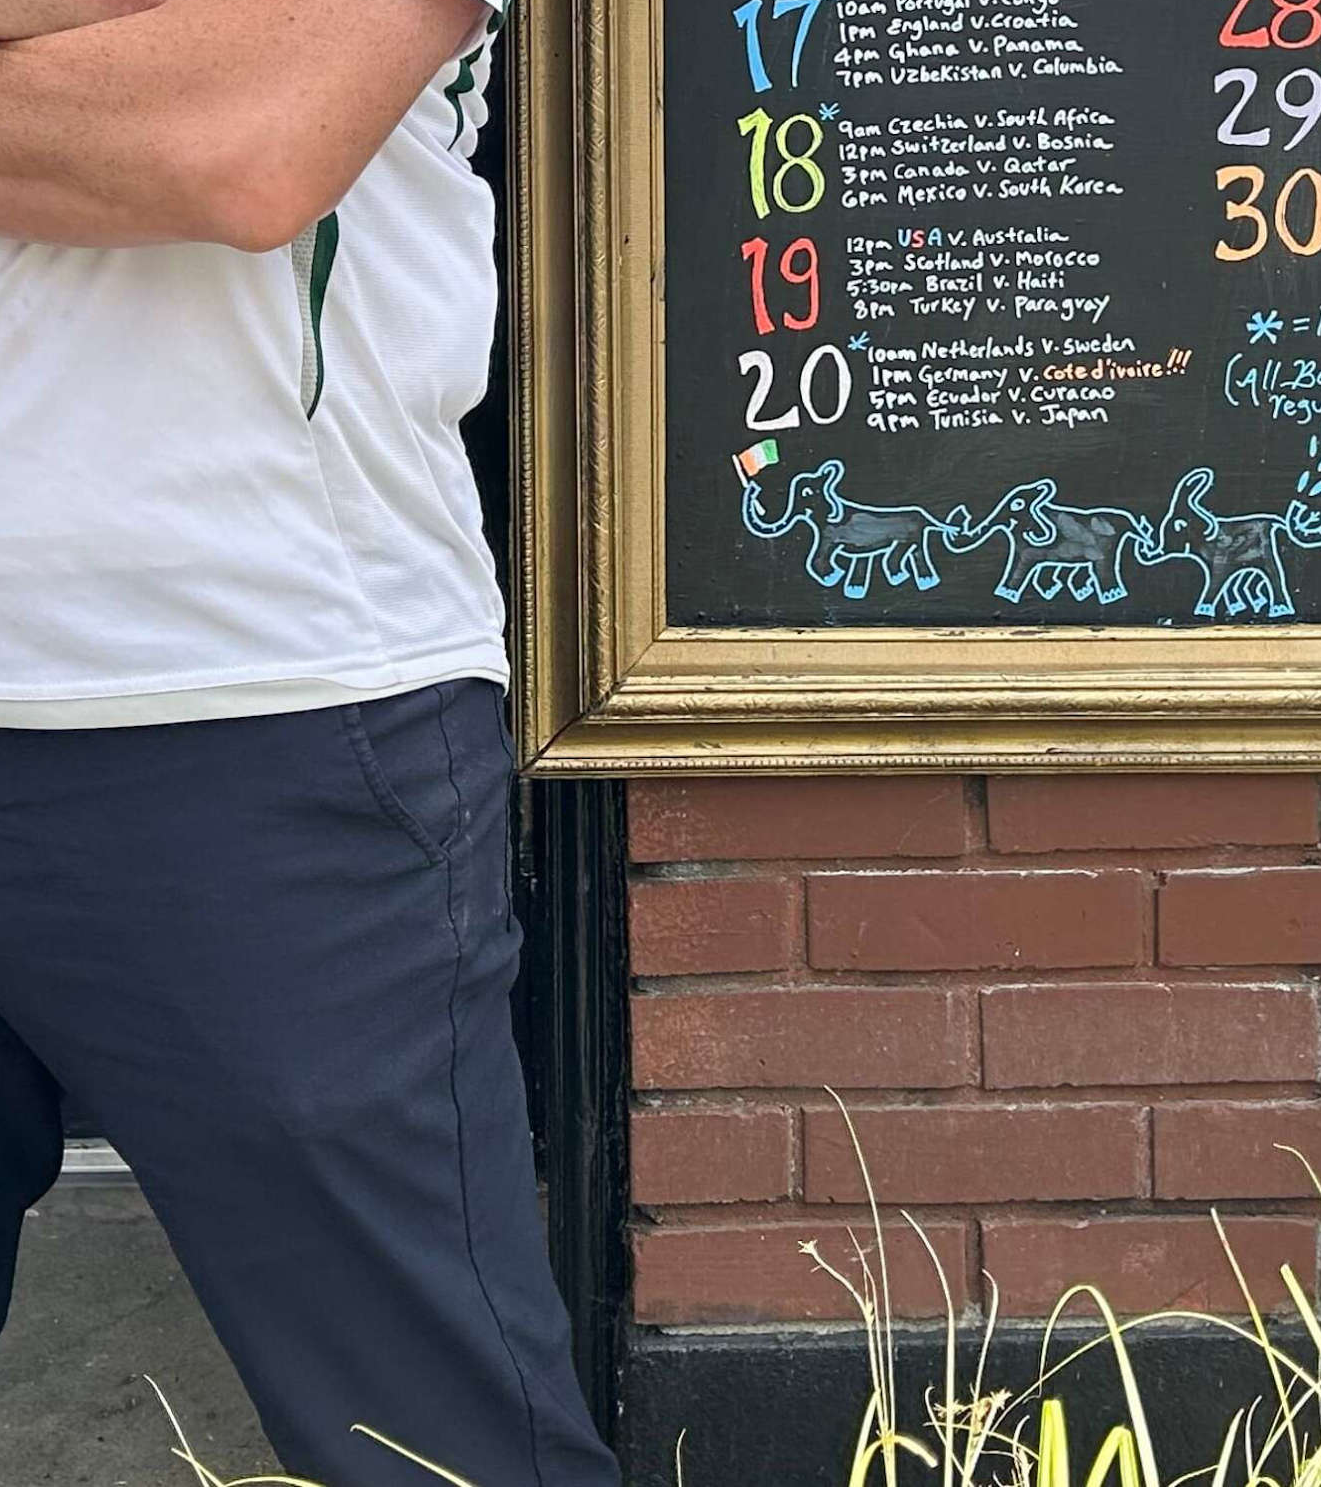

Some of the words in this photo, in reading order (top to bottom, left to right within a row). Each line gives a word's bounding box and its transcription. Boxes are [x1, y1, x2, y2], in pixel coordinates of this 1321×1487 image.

[886, 12, 964, 41] England
[888, 41, 960, 64] Ghana
[993, 34, 1084, 58] Panama
[1032, 55, 1124, 76] Columbia
[1037, 132, 1114, 151] Bosnia
[737, 107, 825, 220] 18
[887, 113, 969, 135] Czechia
[996, 106, 1049, 127] South
[897, 183, 967, 207] Mexico
[997, 176, 1052, 199] South
[1059, 174, 1124, 195] Korea
[741, 236, 819, 335] 19
[897, 227, 942, 248] USA
[972, 226, 1070, 247] Australia
[925, 272, 983, 293] Brazil
[1017, 270, 1065, 291] Haiti
[738, 344, 852, 431] 20
[921, 334, 1034, 360] Netherlands
[917, 364, 1008, 391] Germany
[928, 407, 1004, 431] Tunisia
[1038, 403, 1109, 429] Japan
